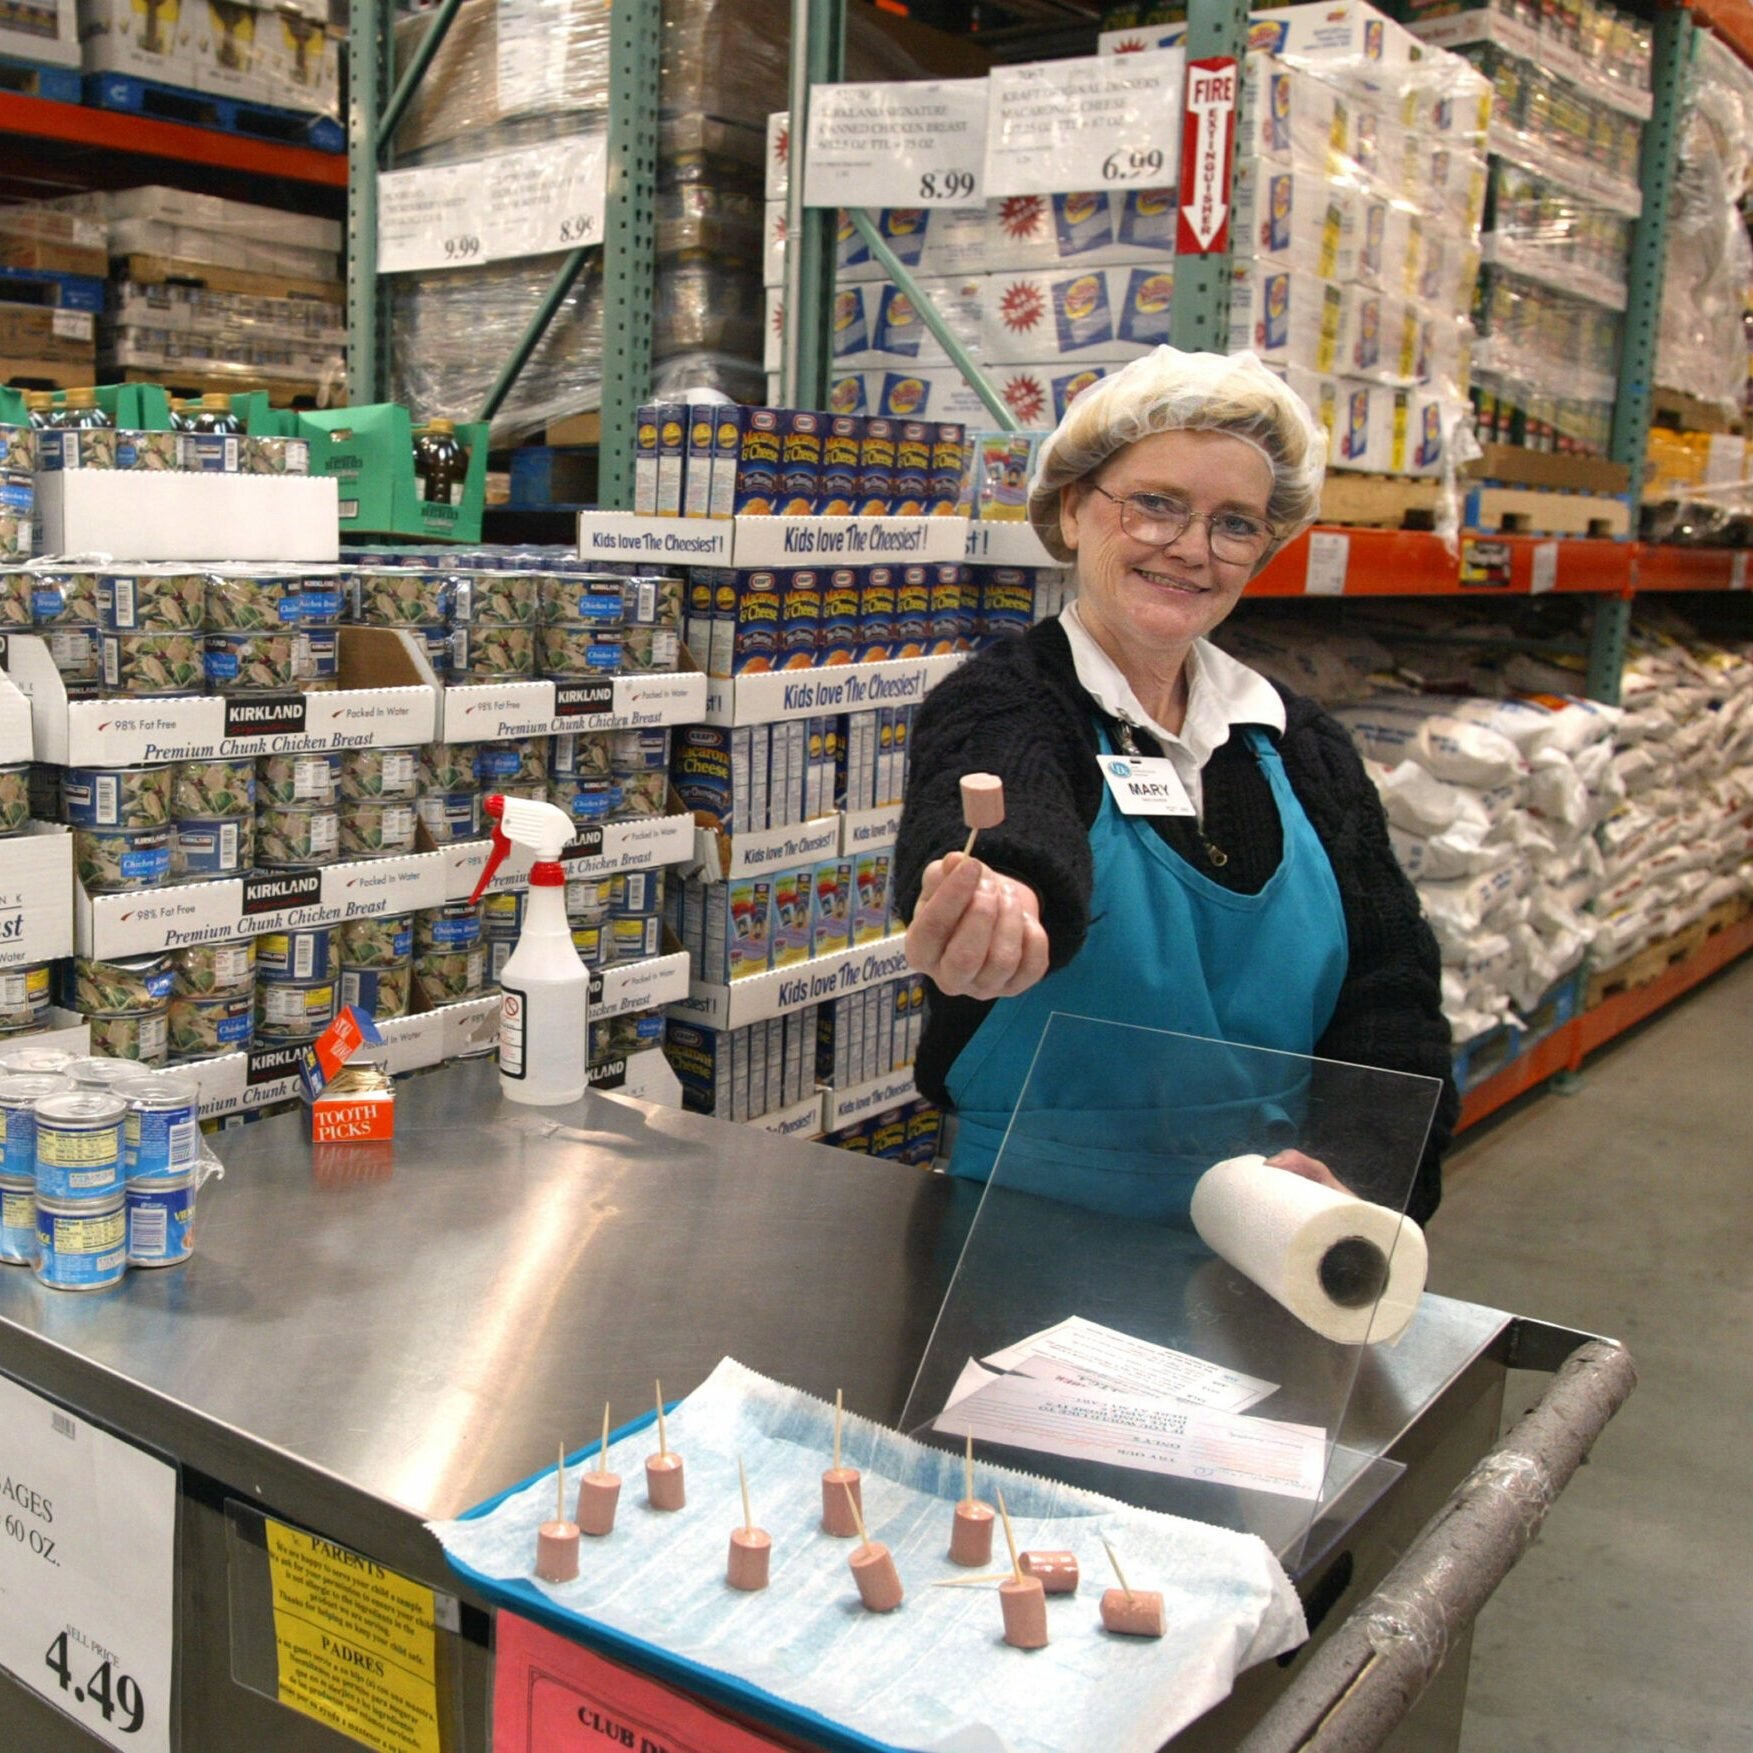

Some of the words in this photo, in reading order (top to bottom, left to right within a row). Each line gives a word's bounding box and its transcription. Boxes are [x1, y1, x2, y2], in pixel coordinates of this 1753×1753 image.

[1194, 77, 1231, 103] FIRE
[926, 121, 968, 132] BREAST
[1200, 108, 1218, 235] EXTINGUISHER
[920, 172, 974, 198] 8.99
[445, 235, 480, 260] 9.99
[592, 531, 616, 549] Kids
[618, 531, 642, 550] love
[642, 532, 663, 551] The
[784, 528, 814, 553] Kids
[816, 528, 844, 551] love
[846, 523, 868, 551] The
[558, 688, 611, 704] KIRKLAND
[783, 683, 813, 711] Kids
[815, 683, 843, 707] love
[845, 675, 867, 702] The
[229, 704, 303, 722] KIRKLAND
[346, 708, 375, 718] Packed
[387, 706, 409, 717] Water
[498, 721, 547, 737] Premium
[550, 716, 585, 732] Chunk
[588, 714, 628, 730] Chicken
[631, 711, 663, 724] Breast
[114, 719, 135, 731] 98%
[139, 719, 155, 730] Fat
[157, 719, 176, 729] Free
[143, 741, 214, 761] Premium
[219, 736, 266, 756] Chunk
[271, 733, 326, 754] Chicken
[331, 732, 374, 748] Breast
[684, 758, 728, 779] Cheese
[1129, 783, 1169, 796] MARY
[853, 824, 870, 841] Kids
[871, 821, 887, 838] love
[744, 848, 765, 865] Kids
[766, 845, 783, 860] love
[784, 840, 798, 857] The
[359, 877, 386, 888] Packed
[398, 872, 421, 884] Water
[487, 870, 530, 888] Premiu
[577, 858, 618, 873] Chicken
[621, 851, 652, 867] Breast
[247, 878, 318, 900] KIRKLAND
[137, 909, 158, 921] 98%
[160, 907, 175, 918] Fat
[177, 904, 195, 916] Free
[164, 925, 232, 947] Premium
[237, 914, 283, 935] Chunk
[287, 906, 342, 930] Chicken
[345, 899, 387, 919] Breast
[778, 981, 808, 1008] Kids
[809, 974, 836, 997] love
[838, 962, 861, 988] The
[620, 994, 651, 1010] Breast
[242, 1088, 287, 1106] Chunk
[315, 1104, 377, 1126] TOOTH
[319, 1121, 371, 1140] PICKS
[0, 1475, 54, 1524] AGES
[5, 1513, 25, 1543] 60
[29, 1529, 61, 1568] OZ.
[311, 1537, 386, 1580] PARENTS
[66, 1623, 89, 1650] SELL
[91, 1638, 120, 1669] PRICE
[321, 1634, 384, 1678] PADRES
[45, 1630, 145, 1734] 4.49
[578, 1706, 634, 1748] CLUB
